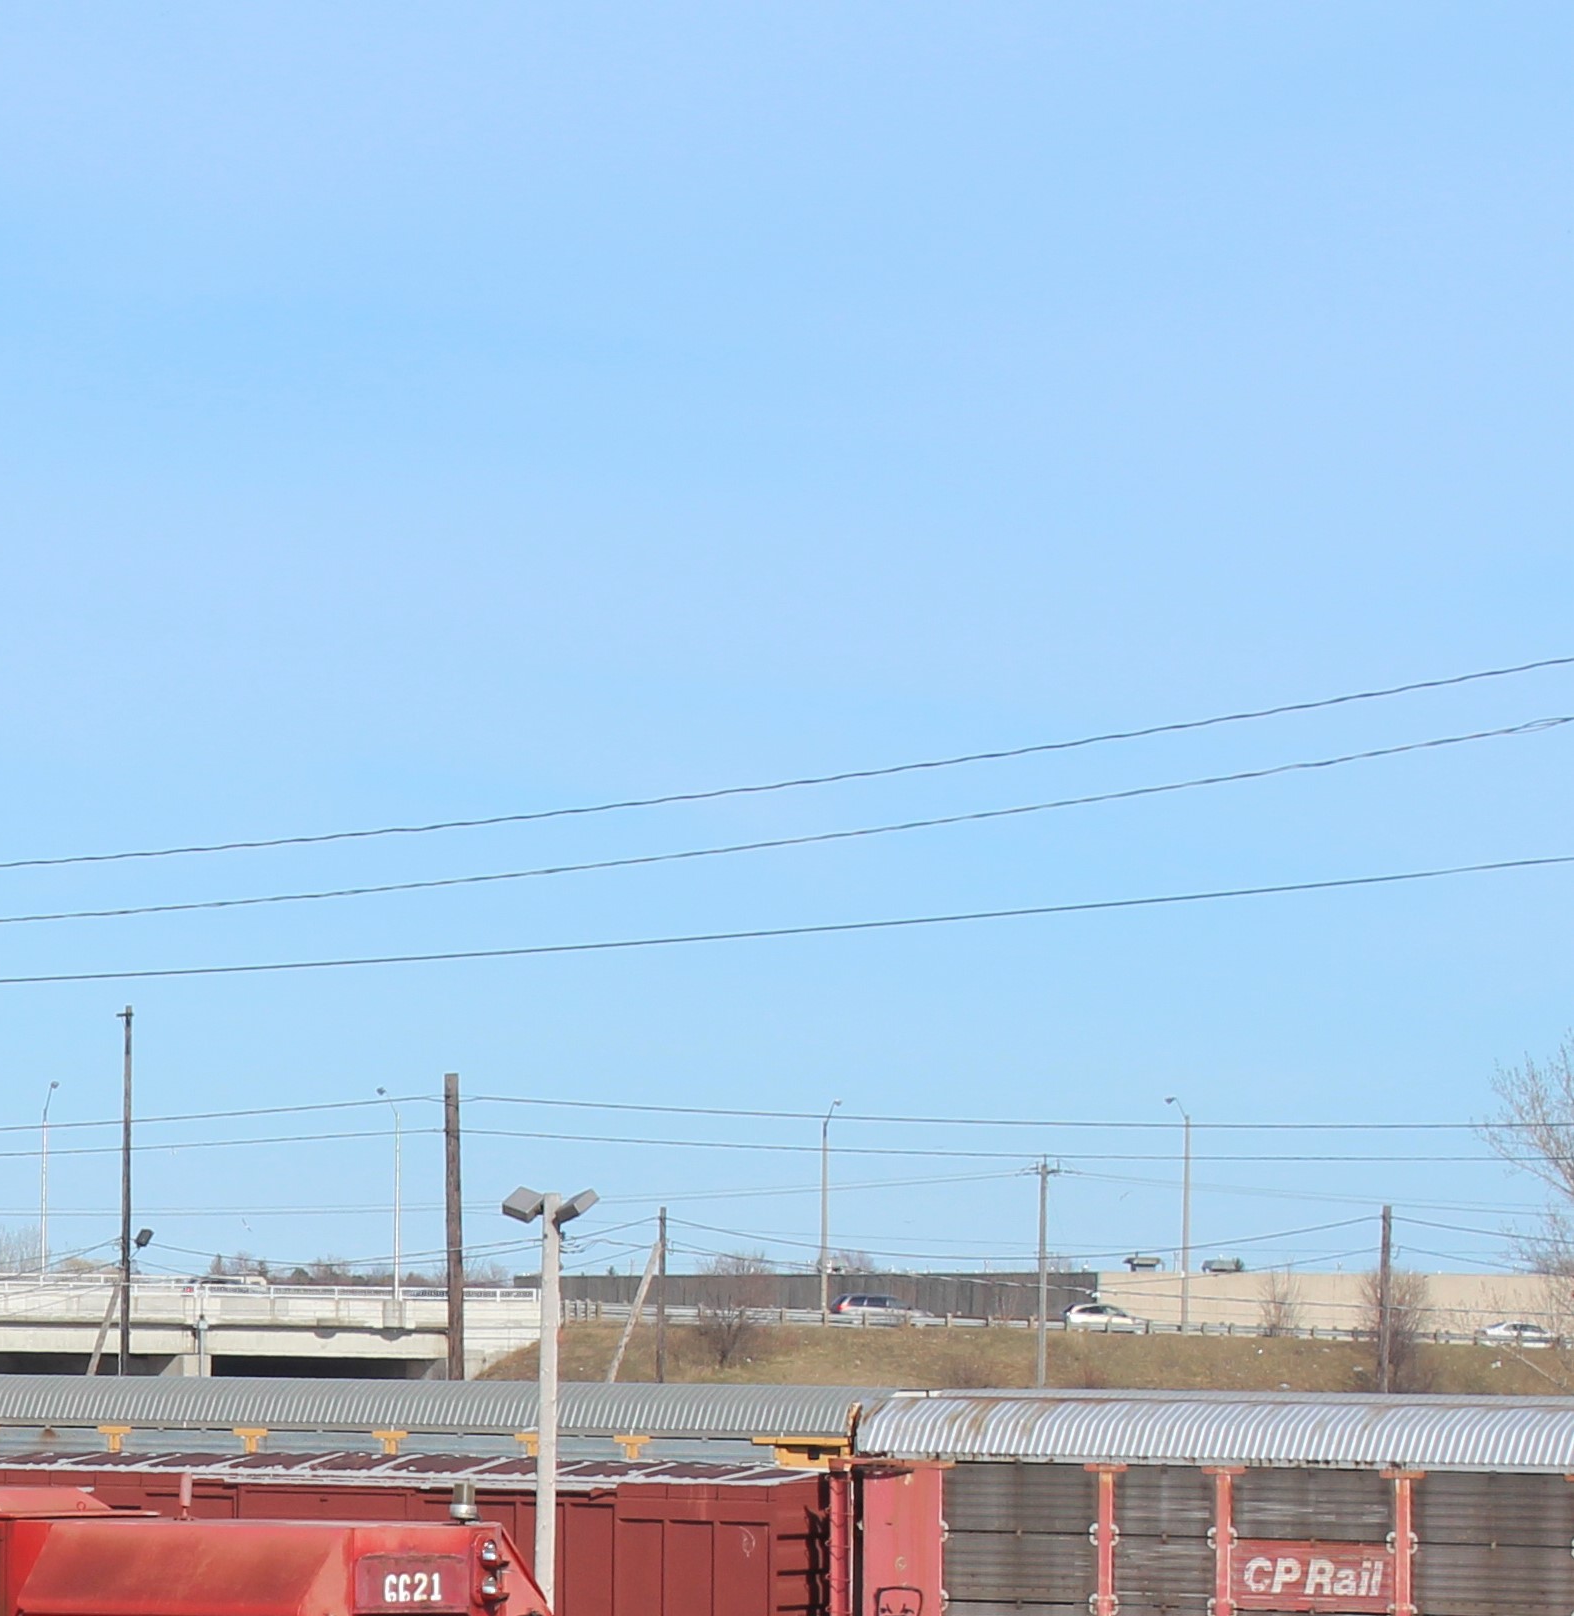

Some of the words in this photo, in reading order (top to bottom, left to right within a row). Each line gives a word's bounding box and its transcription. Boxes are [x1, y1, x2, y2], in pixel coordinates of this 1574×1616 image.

[384, 1572, 442, 1603] 6621
[1243, 1556, 1301, 1593] CP
[1303, 1558, 1384, 1597] Rail
